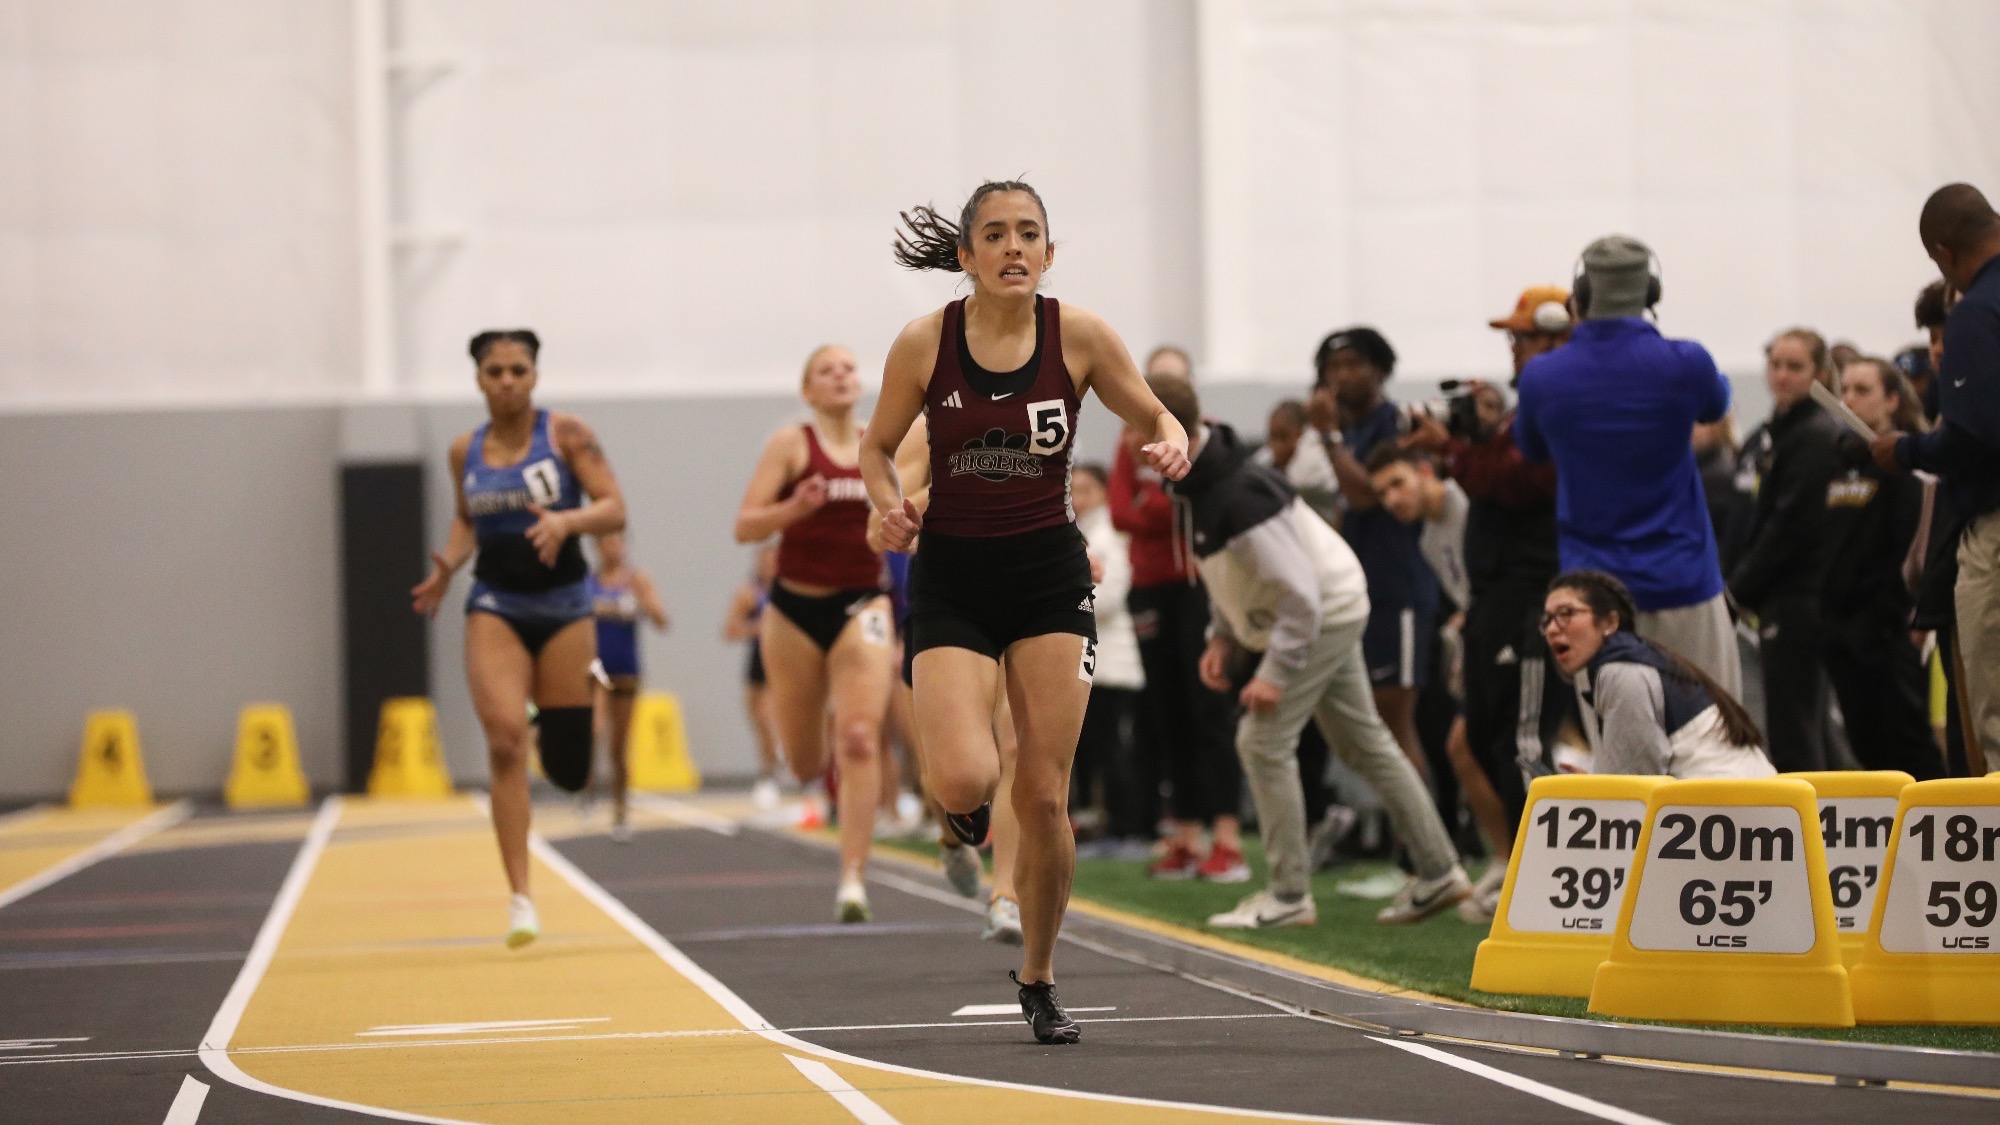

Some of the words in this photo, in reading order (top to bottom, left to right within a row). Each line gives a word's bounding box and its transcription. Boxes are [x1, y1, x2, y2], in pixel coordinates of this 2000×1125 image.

[1035, 407, 1066, 449] 5
[535, 469, 553, 498] 1
[948, 453, 1042, 478] TIGERS
[1537, 806, 1642, 851] 12m
[1657, 813, 1794, 862] 20m
[1819, 805, 1895, 848] 4m
[1549, 866, 1625, 910] 39'
[1679, 879, 1773, 927] 65'
[1828, 865, 1878, 908] 6'
[1562, 917, 1604, 930] UCS
[1696, 934, 1748, 948] UCS
[1942, 936, 1990, 949] UCS
